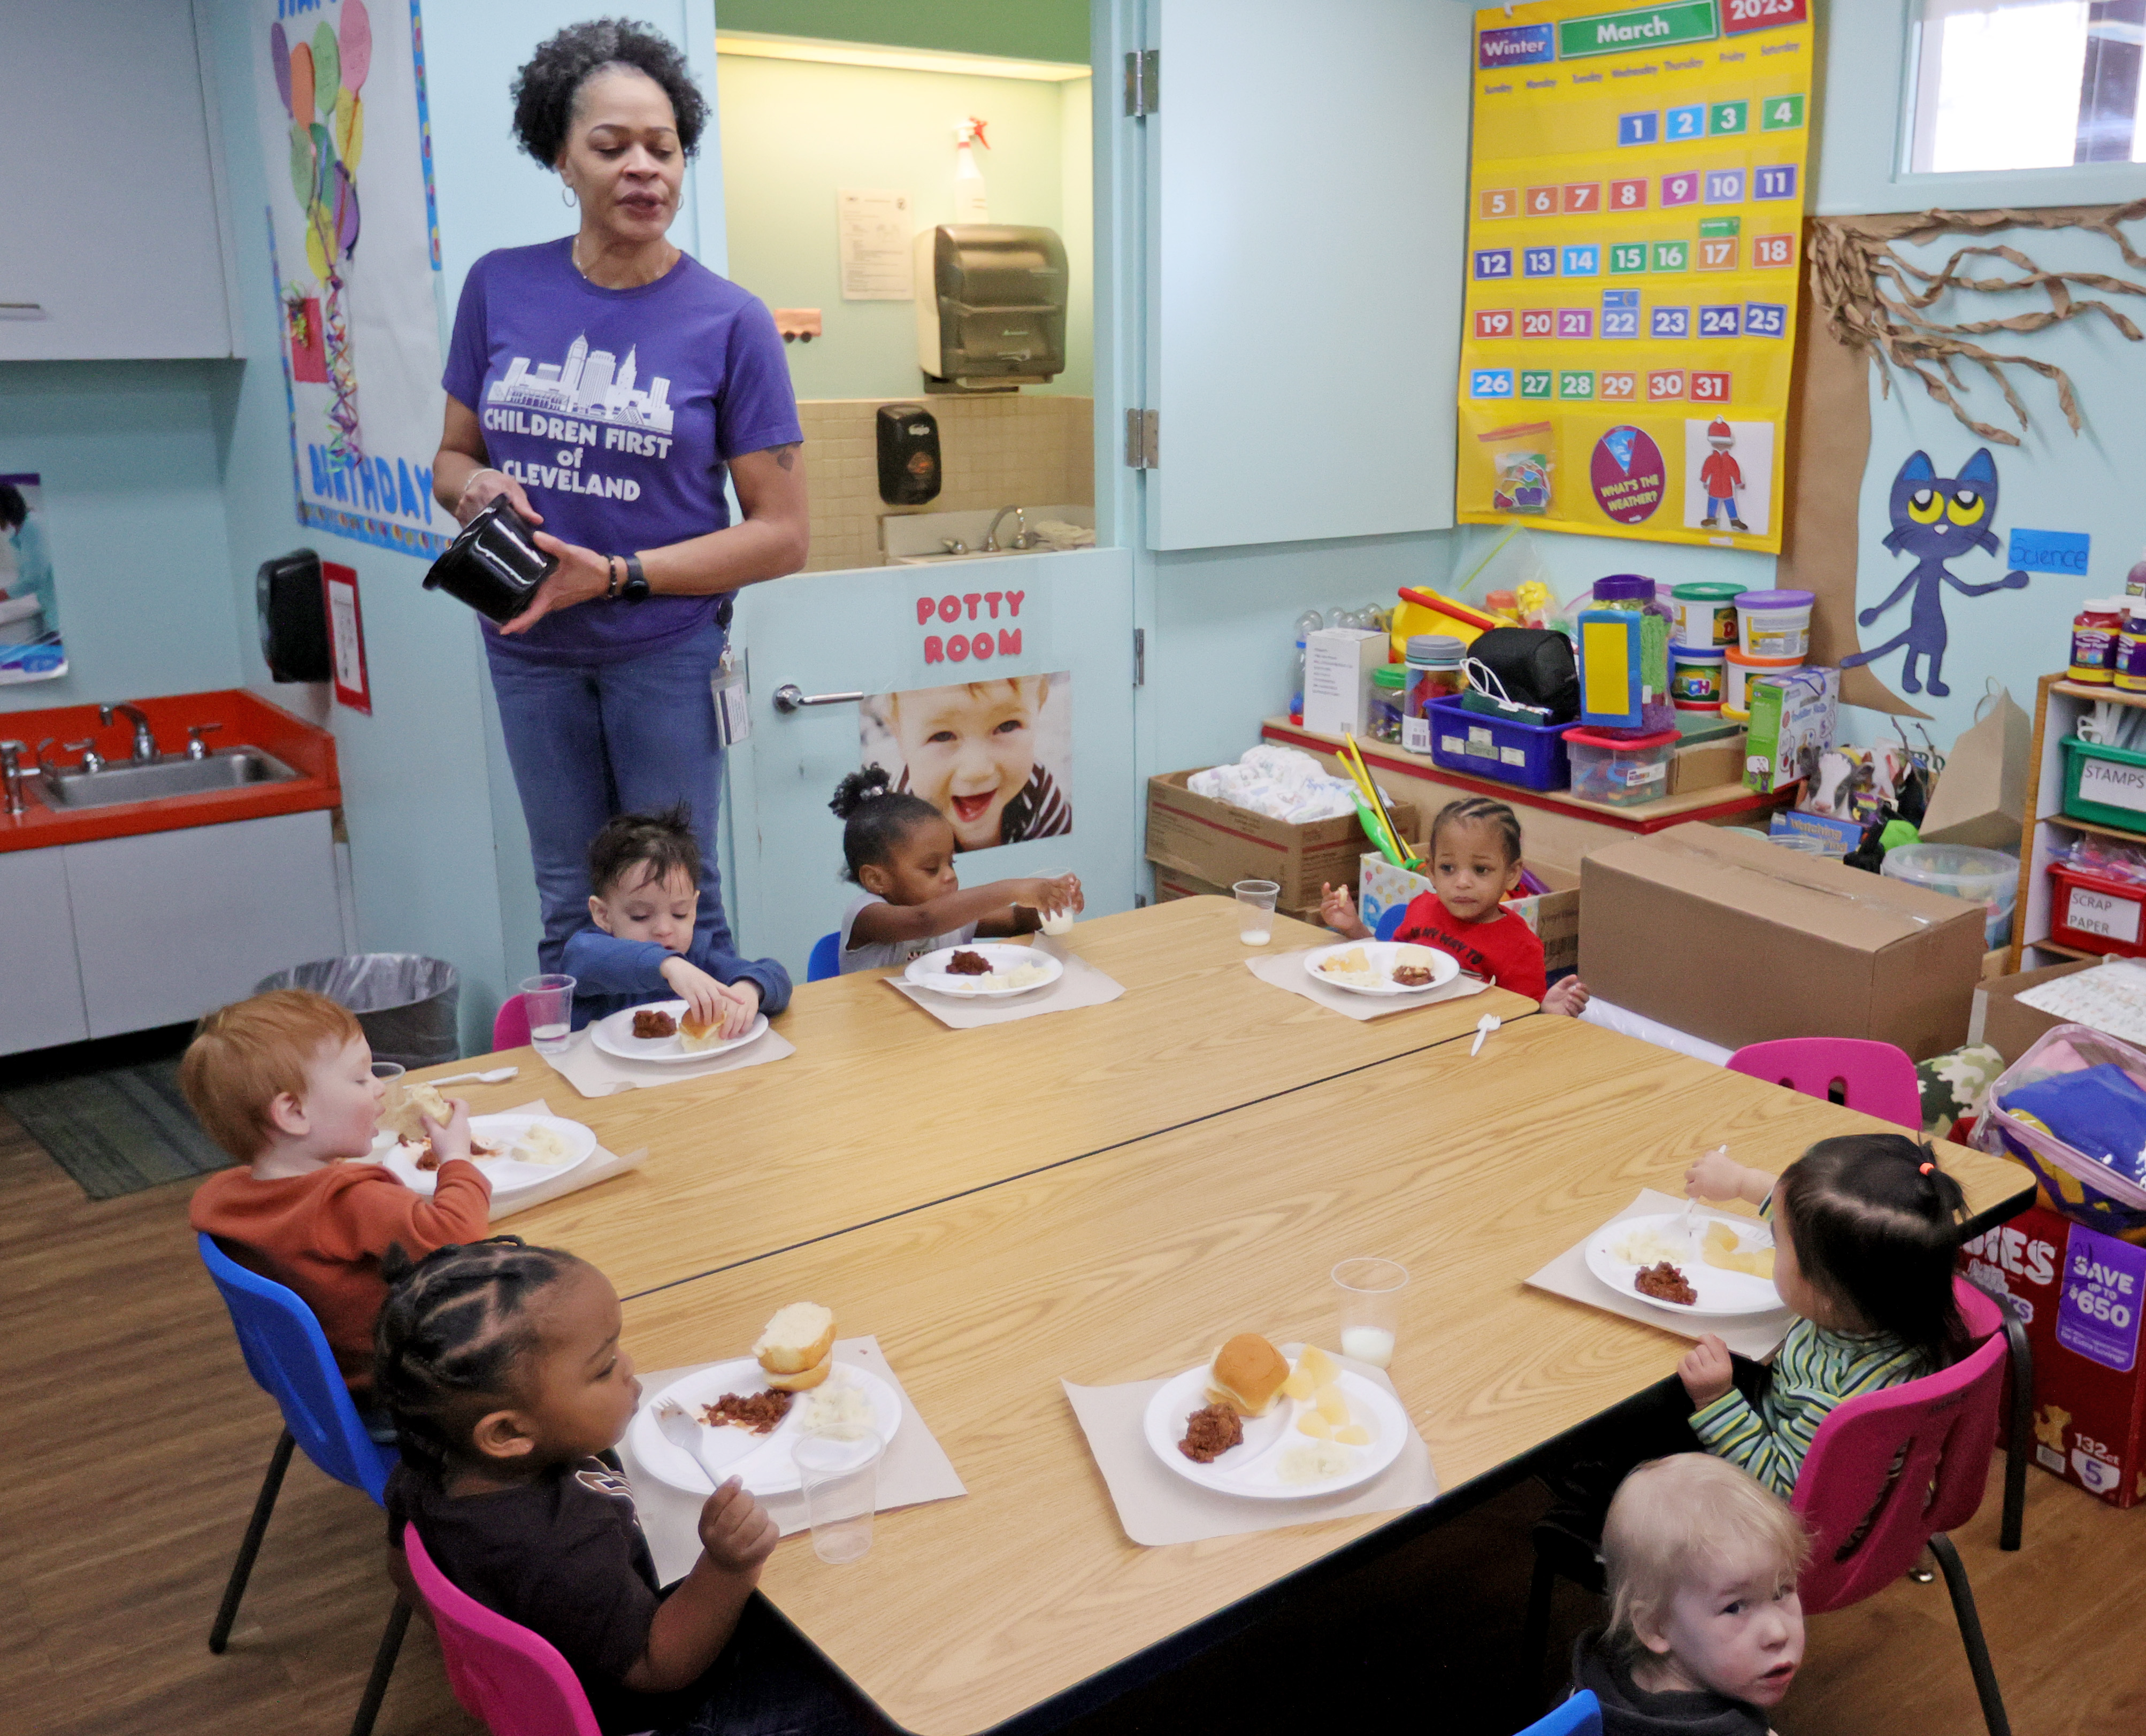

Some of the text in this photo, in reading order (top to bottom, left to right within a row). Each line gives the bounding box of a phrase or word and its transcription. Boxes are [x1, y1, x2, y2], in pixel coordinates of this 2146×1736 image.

[1484, 40, 1546, 57] Winter
[1597, 15, 1670, 44] March
[1633, 102, 1792, 139] 1 2 3 4
[1492, 173, 1786, 213] 5 6 7 8 9 10 11
[1481, 241, 1787, 275] 12 13 14 15 16 17 18
[1482, 310, 1780, 333] 19 20 21 22 23 24 25
[1476, 375, 1722, 397] 26 27 28 29 30 31
[484, 408, 673, 459] CHILDREN FIRST
[556, 447, 584, 468] of
[308, 443, 434, 526] BIRTHDAY
[503, 460, 641, 502] CLEVELAND
[1600, 474, 1660, 497] WHAT'S THE
[1607, 490, 1658, 511] WEATHER?
[2009, 536, 2087, 570] Science
[916, 590, 1025, 626] POTTY
[924, 628, 1022, 664] ROOM
[2086, 765, 2145, 789] STAMPS
[2072, 893, 2112, 911] SCRAP
[2070, 915, 2109, 935] PAPER
[2073, 1255, 2134, 1295] SAVE
[2068, 1283, 2130, 1328] $650
[2103, 1287, 2118, 1301] TO
[2084, 1458, 2103, 1486] 5
